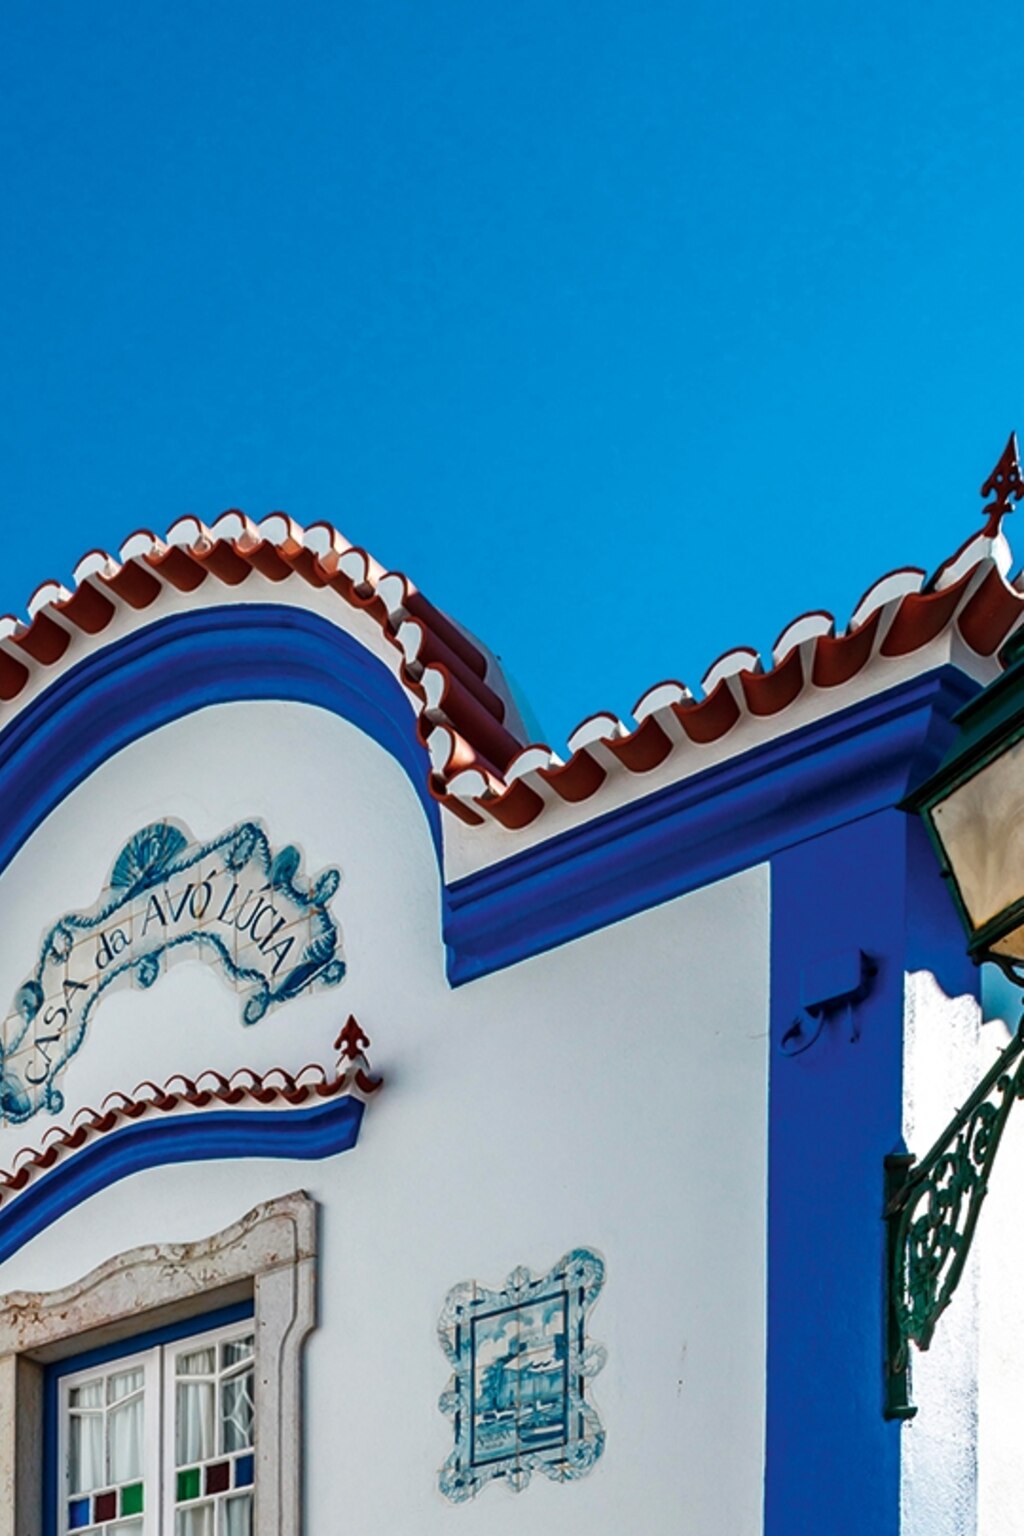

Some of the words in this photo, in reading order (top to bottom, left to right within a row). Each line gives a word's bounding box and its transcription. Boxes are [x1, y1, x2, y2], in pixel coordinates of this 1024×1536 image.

[24, 979, 89, 1085] CASA
[94, 928, 133, 970] da
[141, 869, 217, 937] AVÓ
[217, 882, 296, 976] LÚCIA
